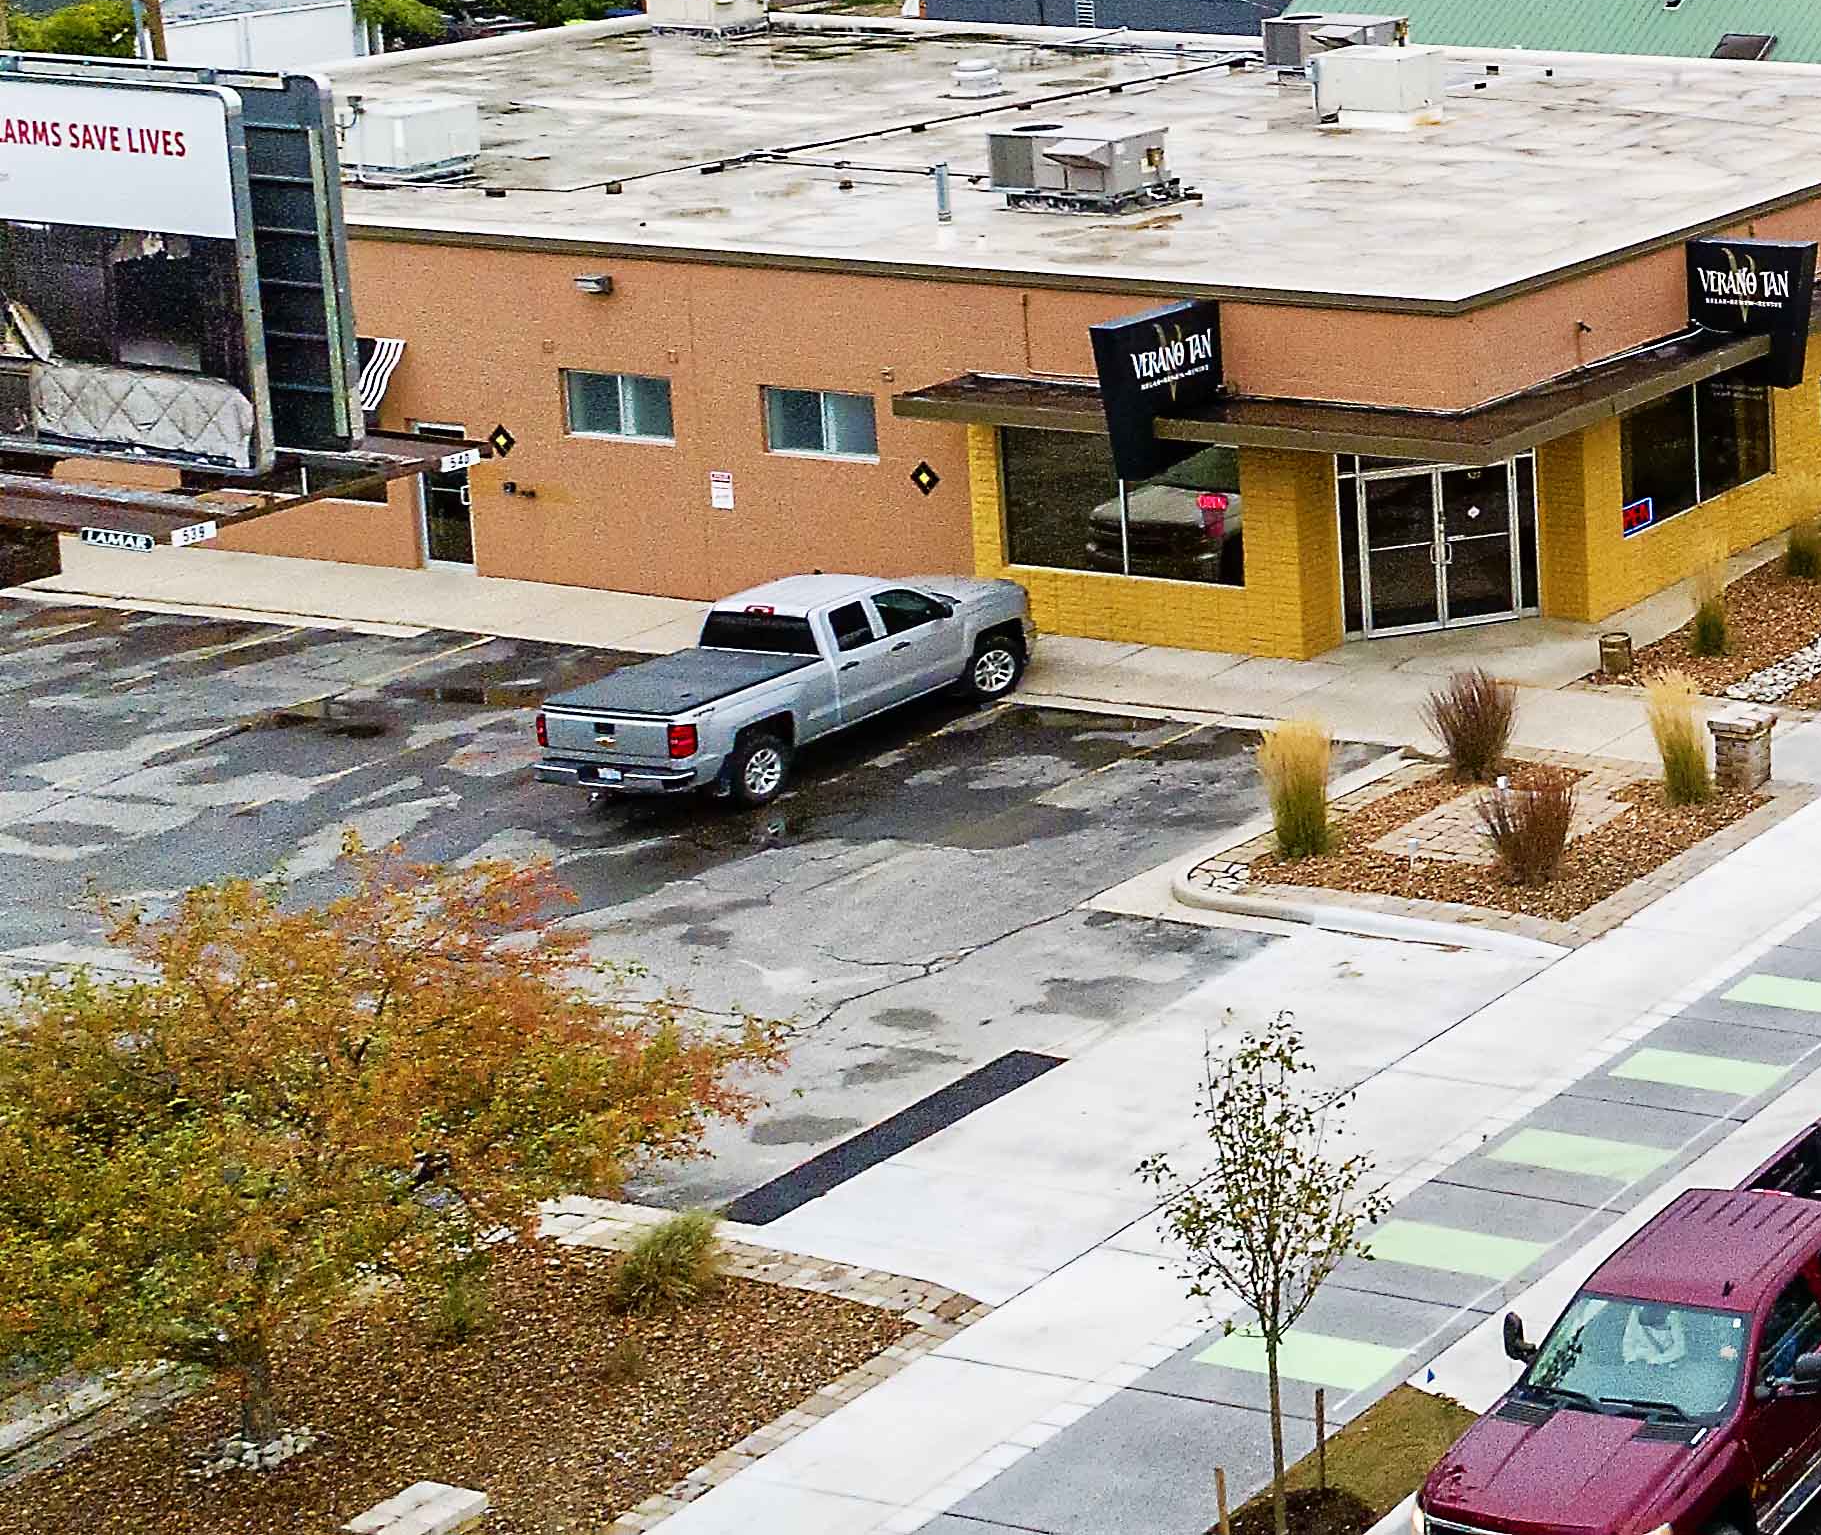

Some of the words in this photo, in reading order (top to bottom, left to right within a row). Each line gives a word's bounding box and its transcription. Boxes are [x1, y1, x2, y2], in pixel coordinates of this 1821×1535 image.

[0, 118, 62, 147] ARMS
[68, 123, 121, 152] SAVE
[127, 127, 187, 157] LIVES
[1696, 267, 1757, 296] VERANO
[1759, 270, 1789, 298] TAN
[1130, 340, 1185, 380] VERANO
[1185, 328, 1212, 364] TAN
[1623, 504, 1649, 530] PEN
[87, 530, 147, 550] LAMAR
[183, 525, 205, 542] 539
